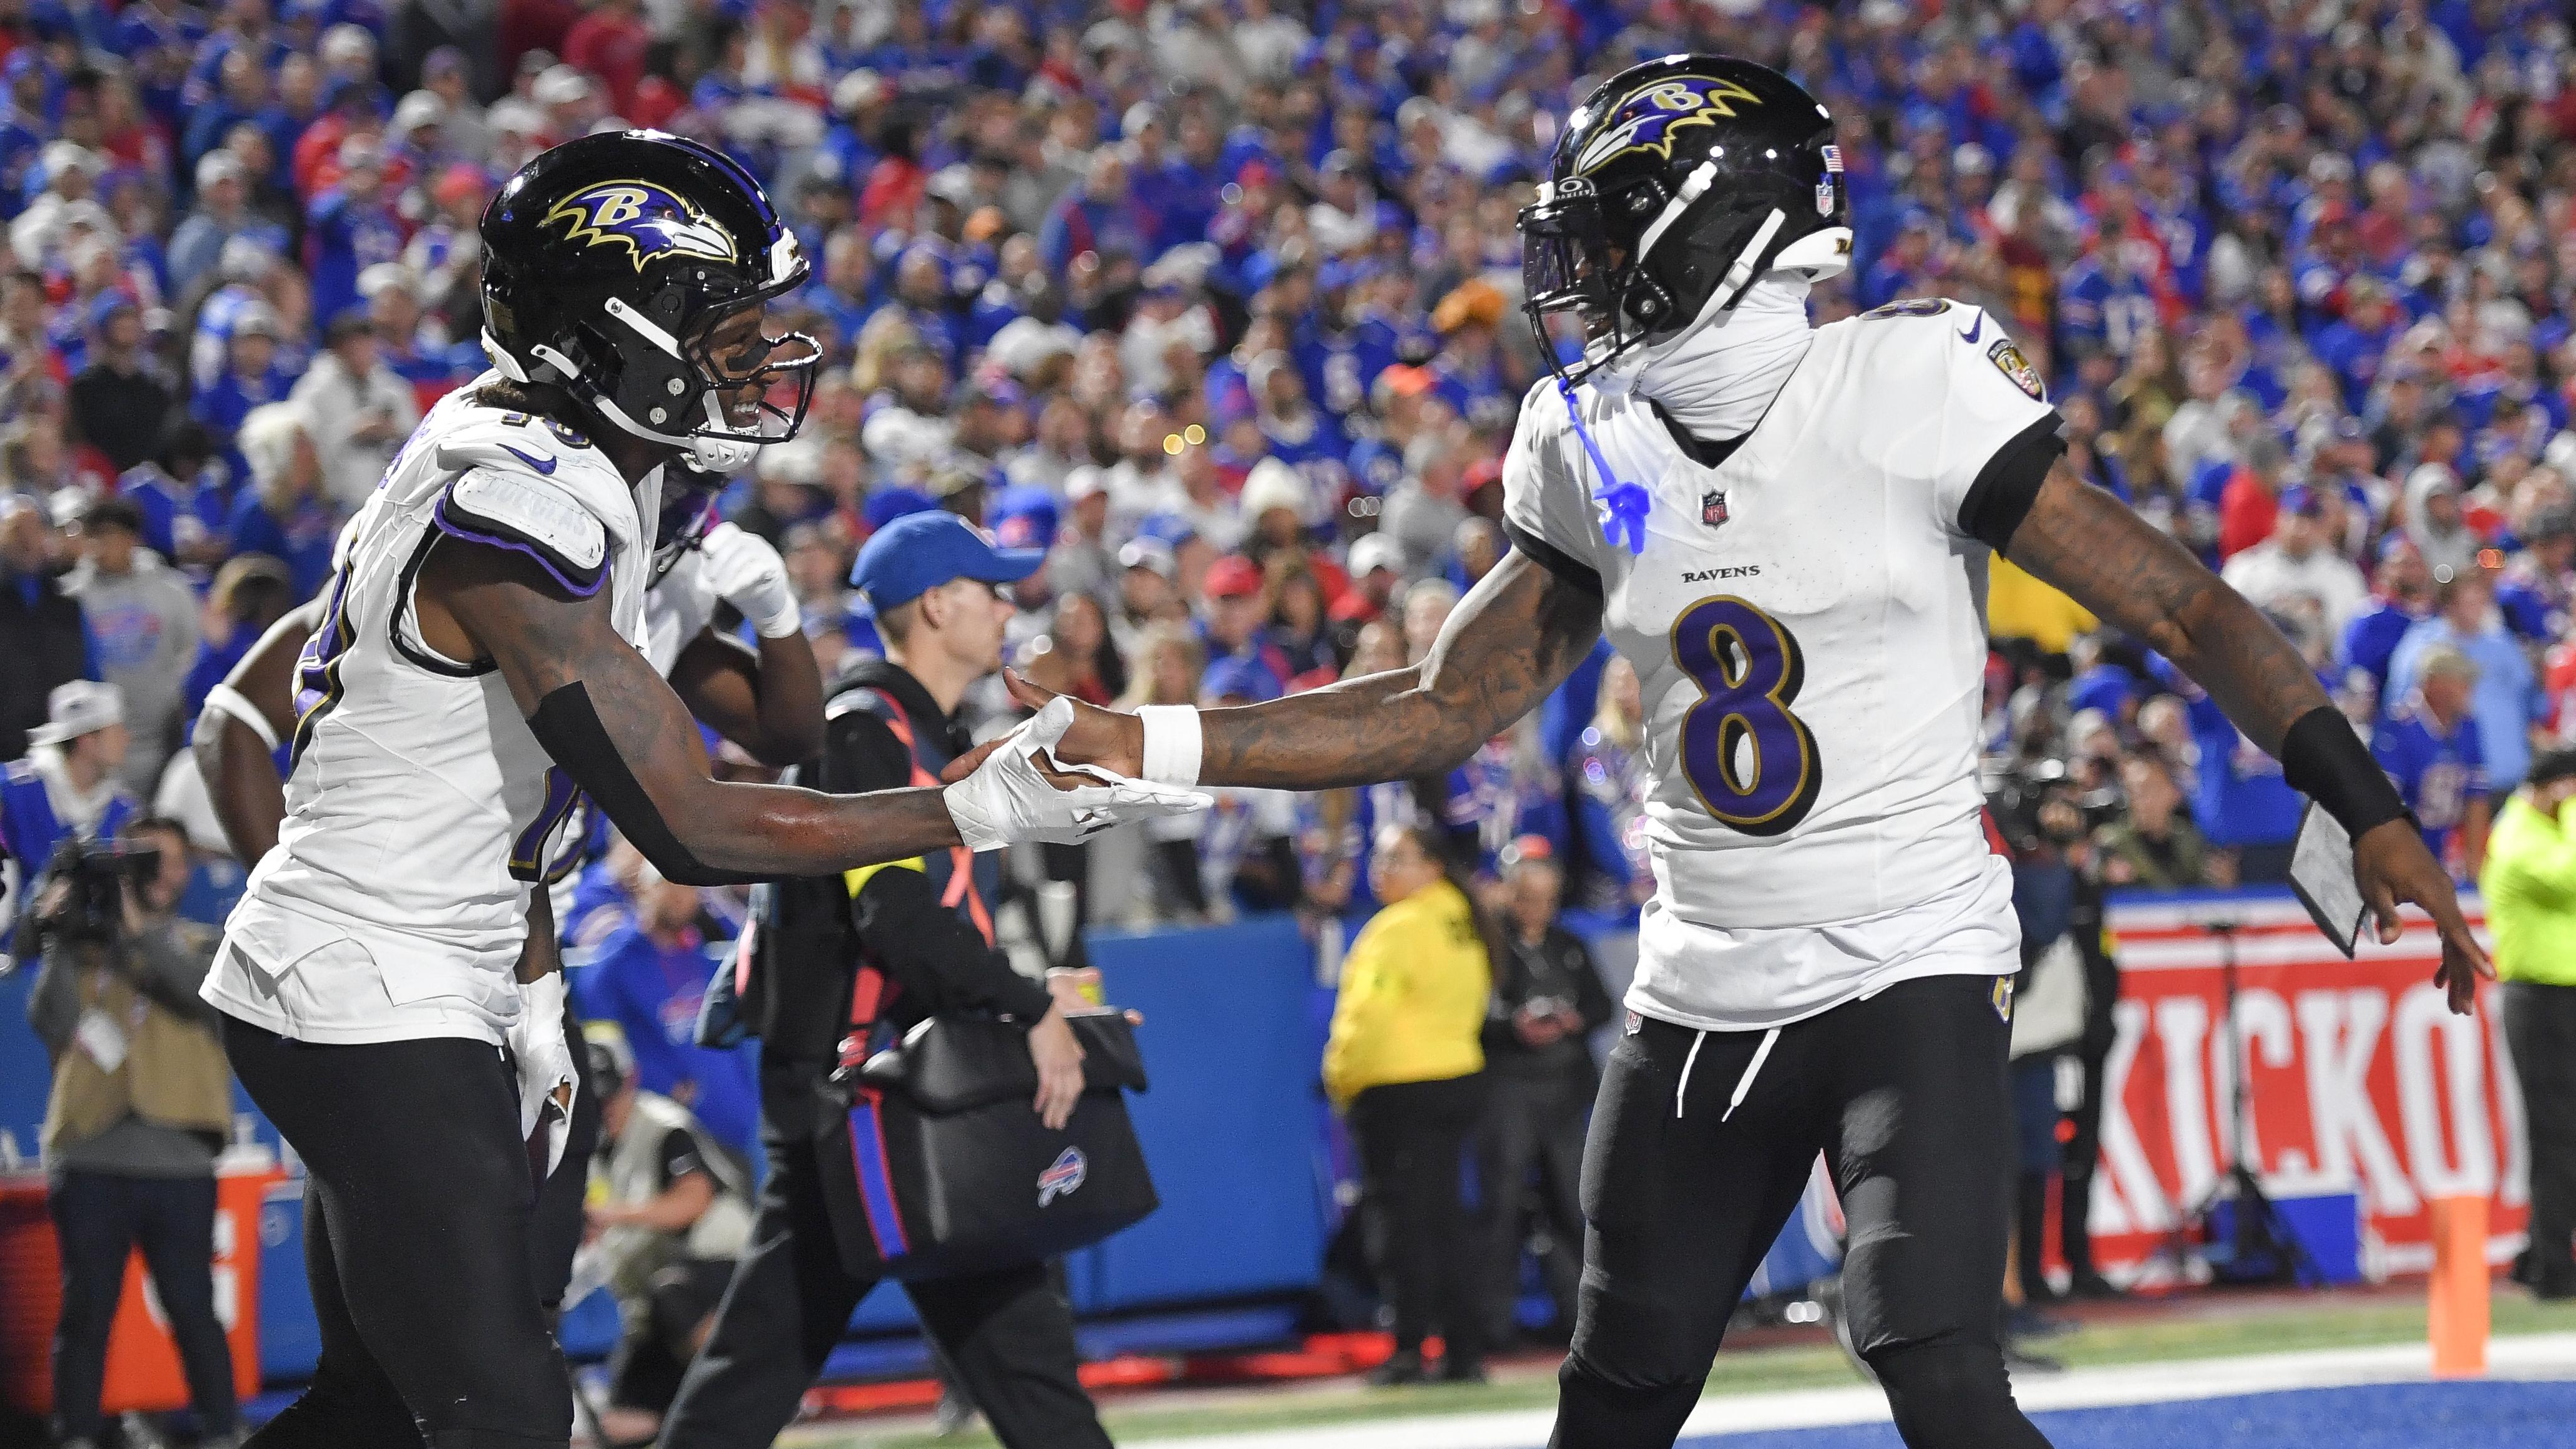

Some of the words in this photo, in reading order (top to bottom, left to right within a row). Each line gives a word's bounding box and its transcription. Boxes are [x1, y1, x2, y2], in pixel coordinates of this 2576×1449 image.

[1626, 83, 1703, 110] B
[581, 188, 648, 226] B
[1681, 565, 1761, 583] RAVENS
[1670, 593, 1823, 837] 8
